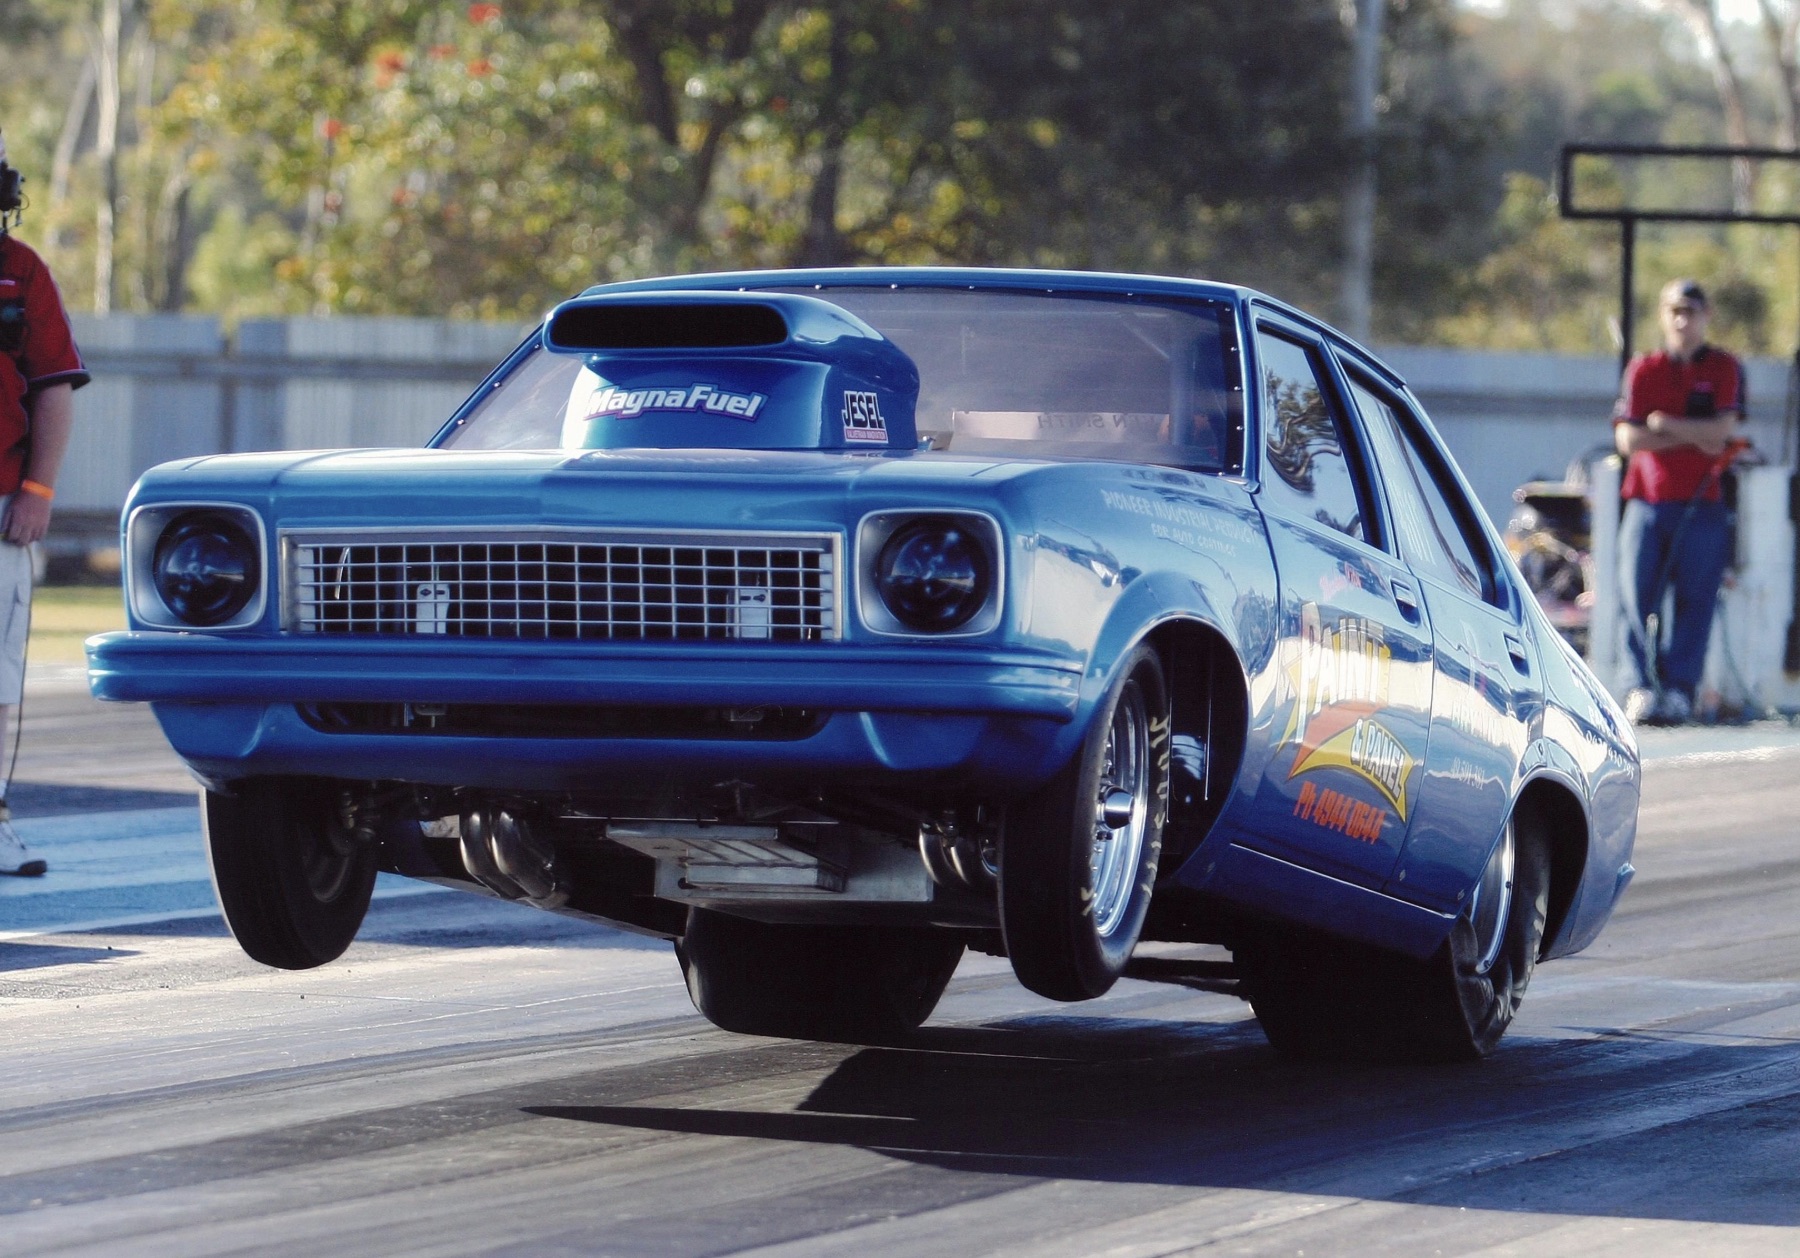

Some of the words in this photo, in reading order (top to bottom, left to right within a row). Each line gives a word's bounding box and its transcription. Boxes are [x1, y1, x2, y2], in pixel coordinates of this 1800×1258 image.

[585, 384, 764, 418] MagnaFuel
[842, 391, 886, 428] JESEL
[1101, 488, 1152, 515] PIONEER
[1295, 601, 1384, 743] PAINT
[1363, 725, 1404, 798] PANEL
